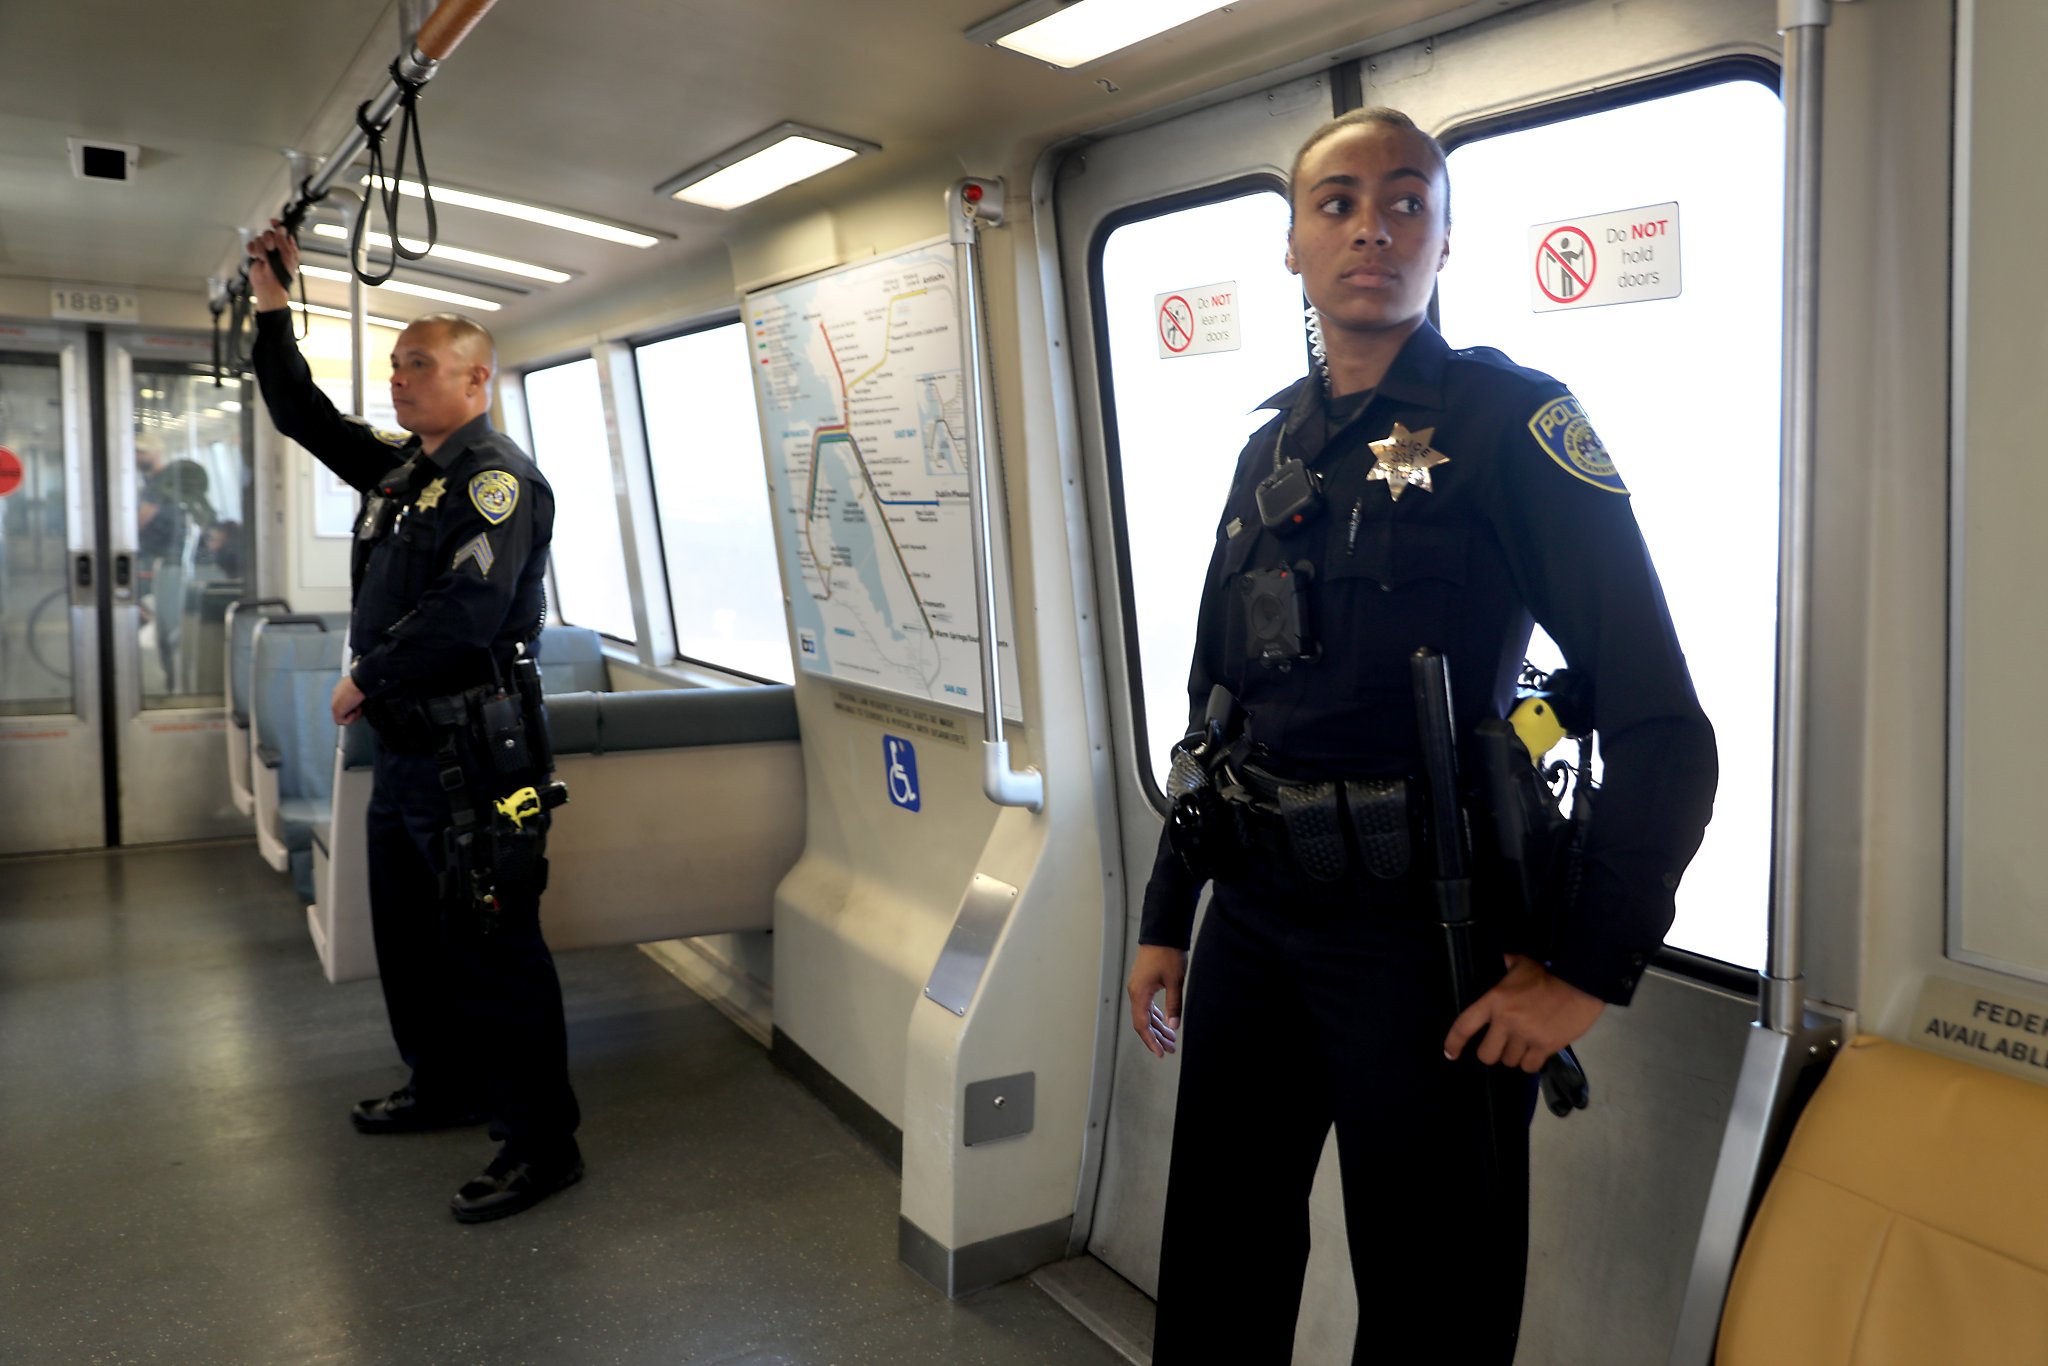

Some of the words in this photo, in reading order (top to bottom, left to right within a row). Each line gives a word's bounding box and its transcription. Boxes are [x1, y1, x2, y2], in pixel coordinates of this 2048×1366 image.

[1606, 227, 1627, 244] Do
[1632, 219, 1668, 240] NOT
[1622, 245, 1653, 265] hold
[1617, 272, 1660, 288] doors
[56, 292, 120, 313] 1889
[1198, 298, 1209, 309] Do
[1211, 293, 1232, 306] NOT
[1207, 330, 1230, 342] doors
[1925, 1018, 2048, 1069] AVAILABL
